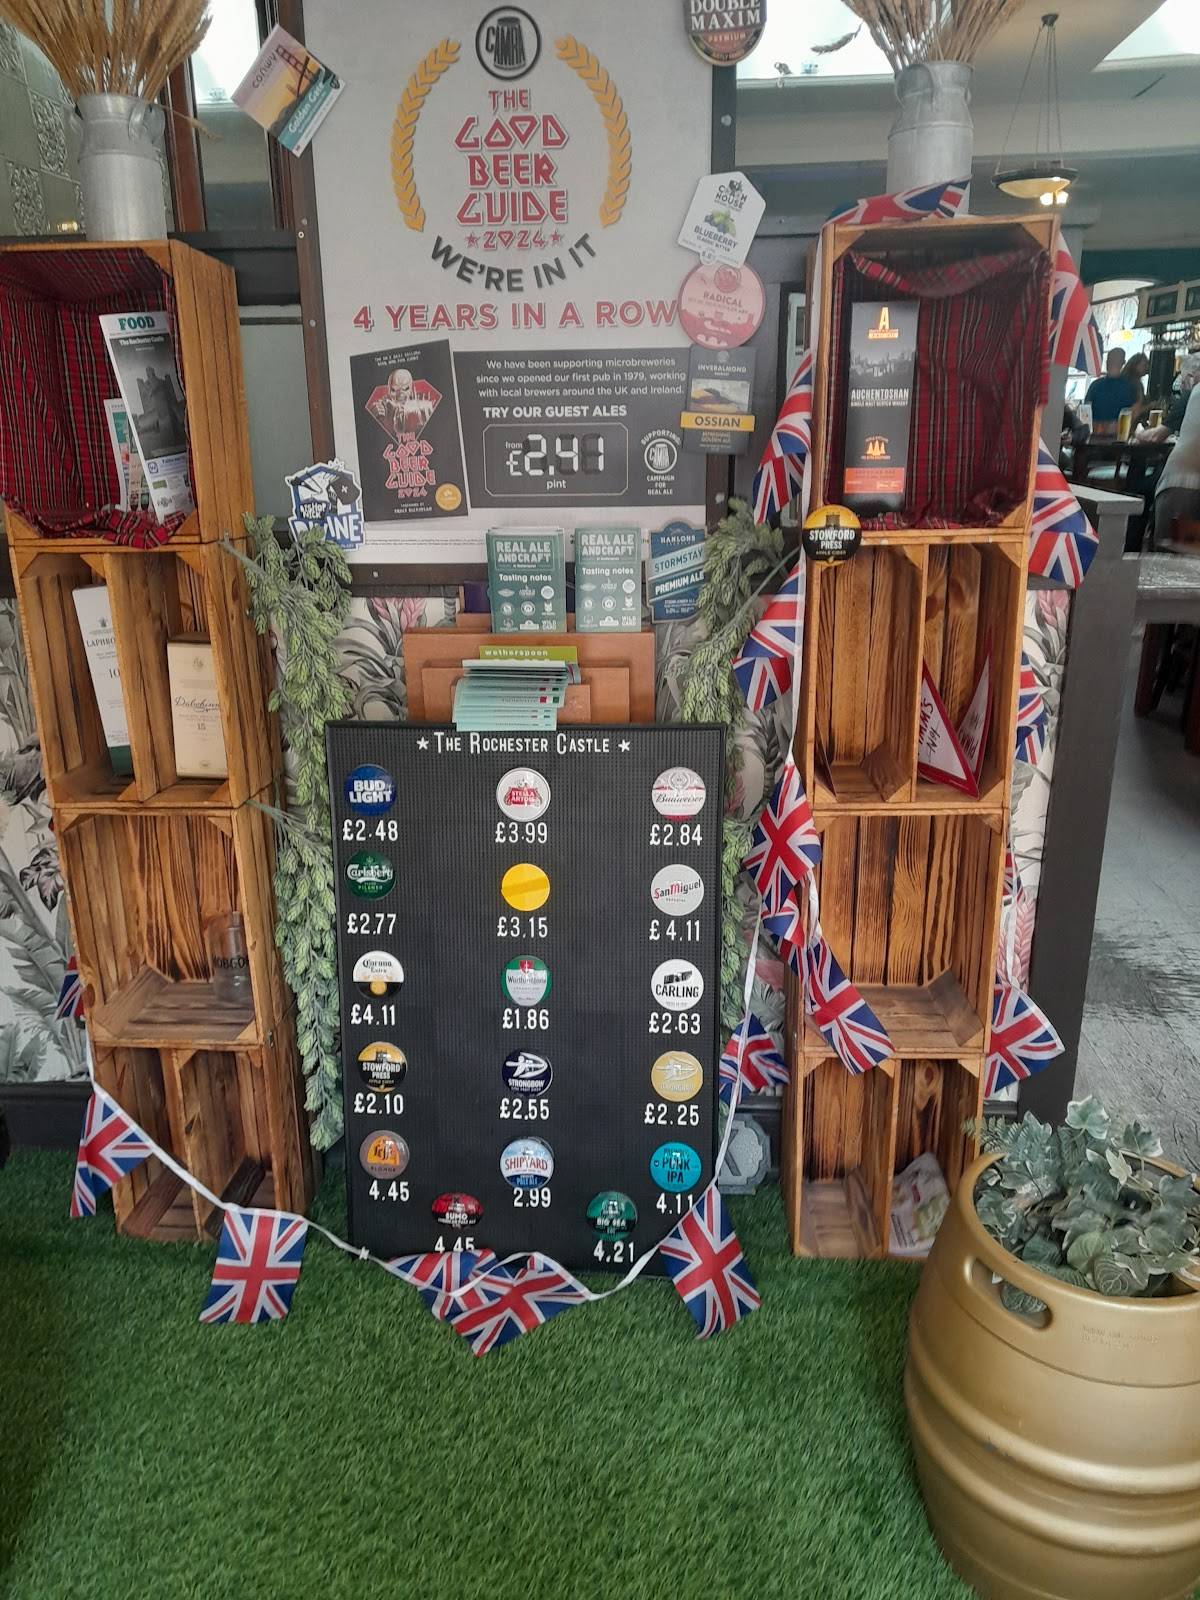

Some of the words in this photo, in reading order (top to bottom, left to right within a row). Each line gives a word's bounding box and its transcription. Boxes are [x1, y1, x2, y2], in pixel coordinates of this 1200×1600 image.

[691, 9, 760, 31] MAXIM
[488, 88, 528, 112] THE
[454, 115, 568, 149] GOOD
[468, 153, 557, 187] BEER
[456, 190, 568, 224] GUIDE
[715, 192, 746, 209] HOUSE
[483, 230, 546, 249] 2024
[693, 225, 739, 249] BLUEBERRY
[430, 235, 525, 292] WE'RE
[533, 257, 566, 289] IN
[568, 232, 597, 268] IT
[703, 290, 743, 309] RADICAL
[117, 315, 156, 331] FOOD
[353, 306, 373, 330] 4
[385, 304, 498, 329] YEARS
[511, 302, 546, 328] IN
[558, 302, 583, 327] A
[596, 300, 678, 327] ROW
[878, 307, 890, 331] A
[487, 359, 502, 369] We
[504, 359, 526, 369] have
[528, 358, 551, 368] been
[553, 357, 603, 370] supporting
[605, 356, 676, 367] microbreweries
[697, 363, 747, 374] INVERALMOND
[476, 373, 500, 384] since
[502, 375, 515, 383] we
[517, 372, 552, 384] opened
[554, 373, 570, 382] our
[572, 371, 591, 383] first
[592, 371, 611, 383] pub
[613, 371, 622, 382] in
[623, 371, 647, 382] 1979,
[649, 370, 686, 382] working
[478, 387, 498, 398] with
[500, 387, 522, 397] local
[524, 386, 561, 398] brewers
[562, 385, 595, 396] around
[597, 386, 612, 396] the
[614, 385, 628, 395] UK
[630, 384, 648, 395] and
[650, 384, 685, 395] Ireland.
[851, 388, 909, 401] AUCHENTOSHAN
[483, 406, 510, 419] TRY
[512, 405, 542, 418] OUR
[545, 405, 590, 418] GUEST
[592, 404, 628, 417] ALES
[694, 415, 741, 428] OSSIAN
[505, 441, 523, 450] from
[640, 429, 682, 447] SUPPORTING
[383, 440, 434, 459] GOOD
[389, 455, 431, 472] BEER
[385, 470, 437, 489] GUIDE
[546, 479, 567, 491] pint
[302, 508, 322, 519] NICK
[293, 514, 361, 542] DINE
[809, 528, 856, 541] STOWFORD
[496, 541, 527, 553] REAL
[529, 541, 551, 553] ALE
[581, 534, 611, 546] REAL
[613, 534, 635, 545] ALE
[660, 535, 696, 544] HANLONS
[820, 540, 843, 550] PRESS
[498, 553, 517, 563] AND
[517, 553, 552, 563] CRAFT
[582, 546, 601, 556] AND
[602, 546, 633, 556] CRAFT
[654, 547, 704, 573] STORMSTAY
[499, 573, 528, 583] Tasting
[530, 574, 552, 582] notes
[582, 567, 610, 577] Tasting
[612, 566, 634, 575] notes
[655, 574, 690, 597] PREMIUM
[690, 569, 705, 584] ALE
[484, 648, 548, 657] wetherspoon
[354, 779, 386, 791] BUD
[349, 790, 392, 803] LIGHT
[656, 793, 704, 803] Budweiser
[342, 819, 399, 842] £2.48
[495, 821, 548, 844] £3.99
[650, 823, 703, 846] £2.84
[347, 863, 394, 881] Carlsberg
[347, 912, 397, 936] £2.77
[497, 916, 549, 939] £3.15
[649, 919, 700, 942] £4.11
[362, 959, 392, 969] Corona
[655, 983, 699, 998] CARLING
[351, 1004, 396, 1026] £4.11
[503, 1008, 550, 1031] £1.86
[649, 1012, 701, 1035] £2.63
[362, 1061, 401, 1073] STOWFORD
[372, 1071, 391, 1080] PRESS
[508, 1078, 546, 1088] STRONGBOW
[353, 1092, 404, 1116] £2.10
[500, 1097, 550, 1121] £2.55
[644, 1102, 700, 1126] £2.25
[504, 1156, 548, 1171] SHIPYARD
[662, 1157, 690, 1171] PUNK
[667, 1170, 684, 1184] IPA
[369, 1179, 410, 1202] 4.45
[513, 1187, 551, 1208] 2.99
[656, 1192, 693, 1215] 4.11
[434, 1235, 476, 1253] 445
[593, 1240, 634, 1263] 4.21
